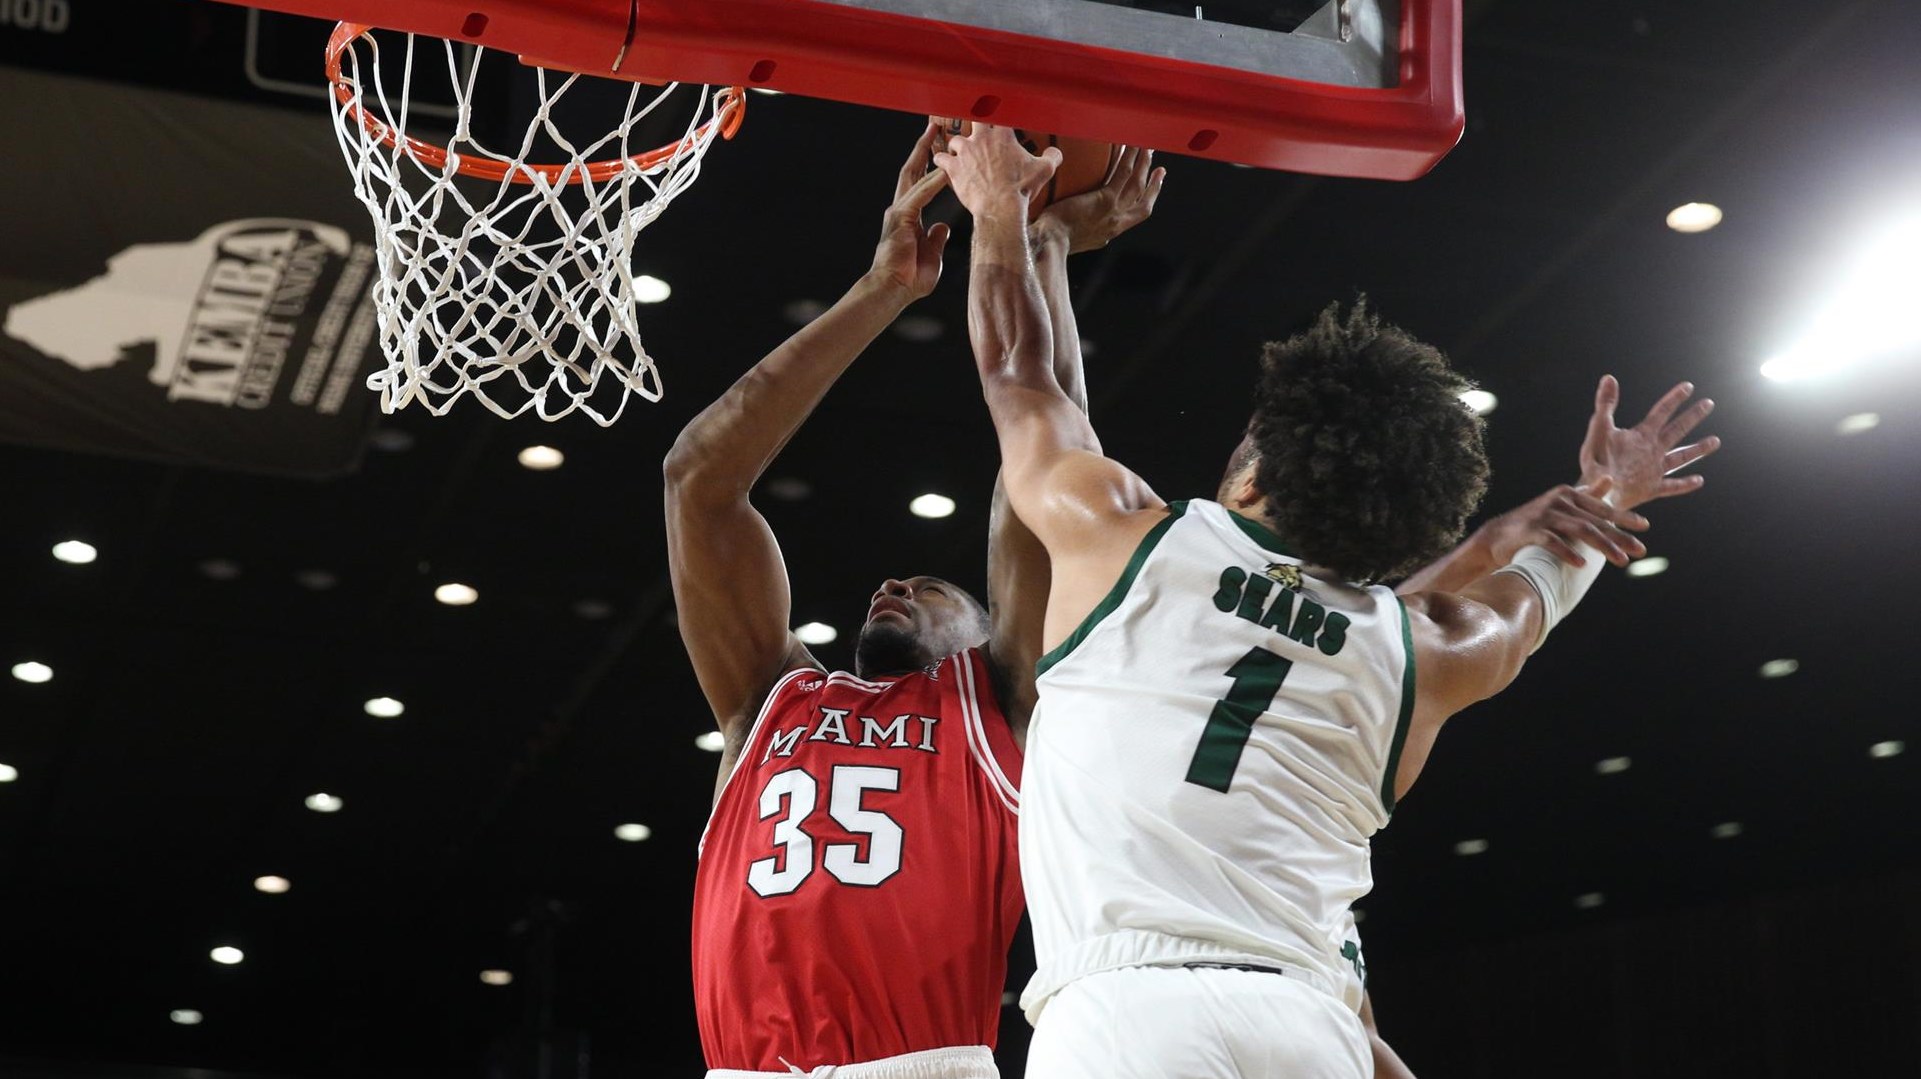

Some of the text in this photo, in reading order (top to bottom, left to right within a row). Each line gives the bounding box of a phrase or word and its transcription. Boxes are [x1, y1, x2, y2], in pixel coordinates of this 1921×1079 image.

[167, 229, 299, 406] KEMBA
[236, 239, 328, 409] CREDIT UNION
[1212, 566, 1351, 656] SEARS
[760, 705, 940, 766] MAMI
[1185, 645, 1294, 794] 1
[748, 764, 905, 898] 35
